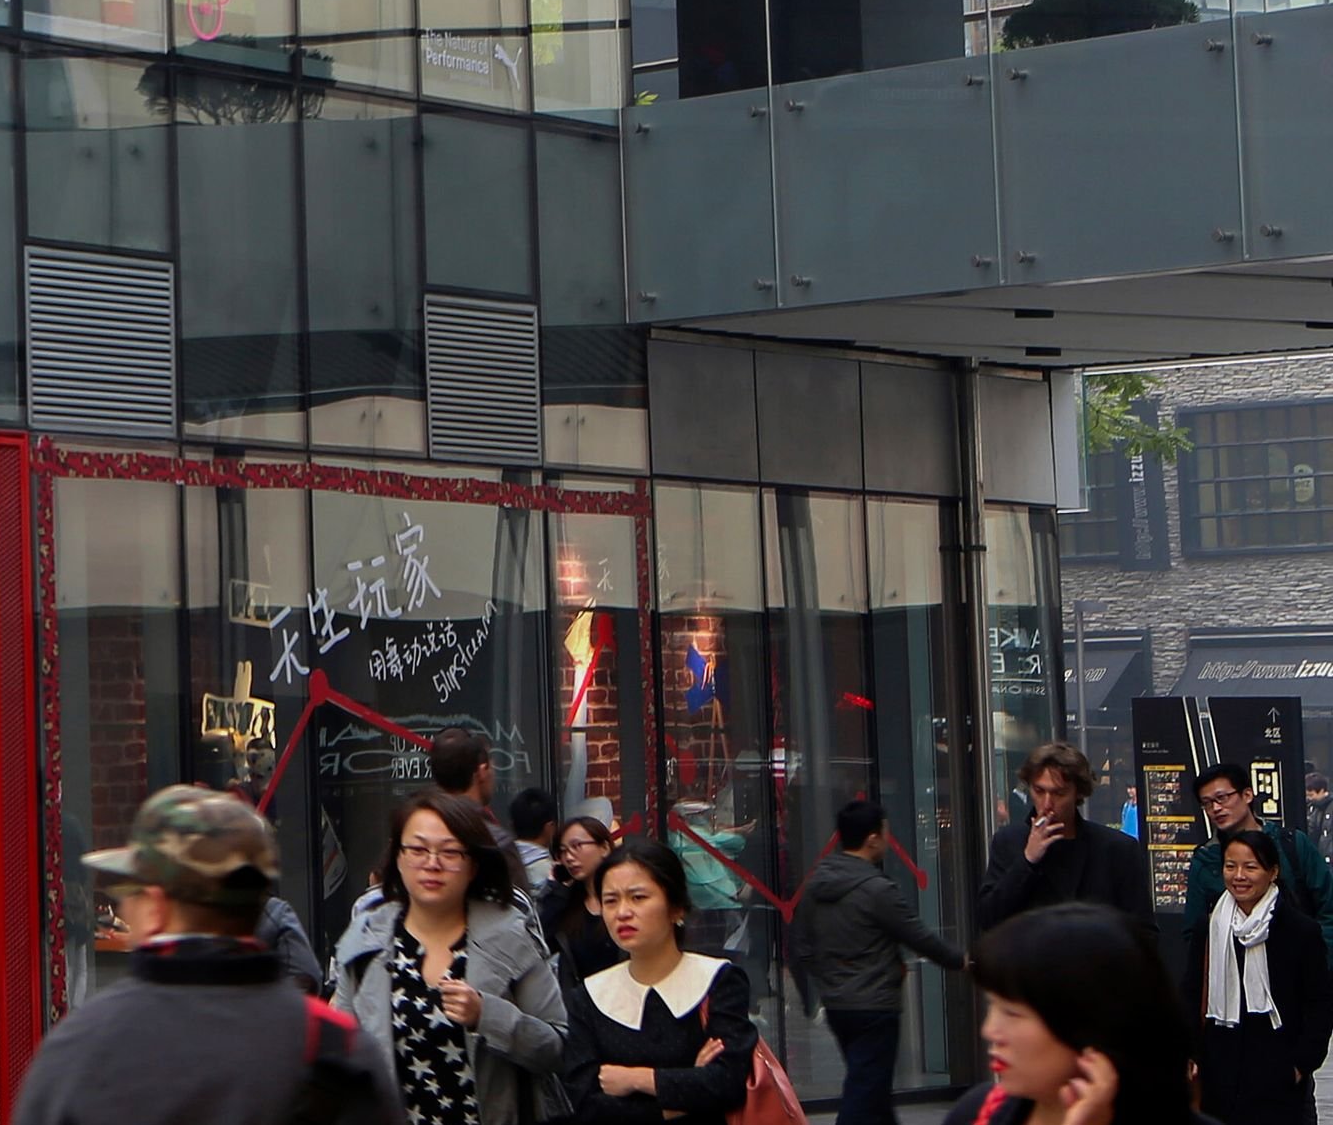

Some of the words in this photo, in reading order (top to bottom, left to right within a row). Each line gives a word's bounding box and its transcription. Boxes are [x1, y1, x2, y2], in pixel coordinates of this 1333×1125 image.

[445, 31, 477, 53] Nature
[426, 47, 489, 75] Performance
[269, 510, 442, 684] 天生玩家
